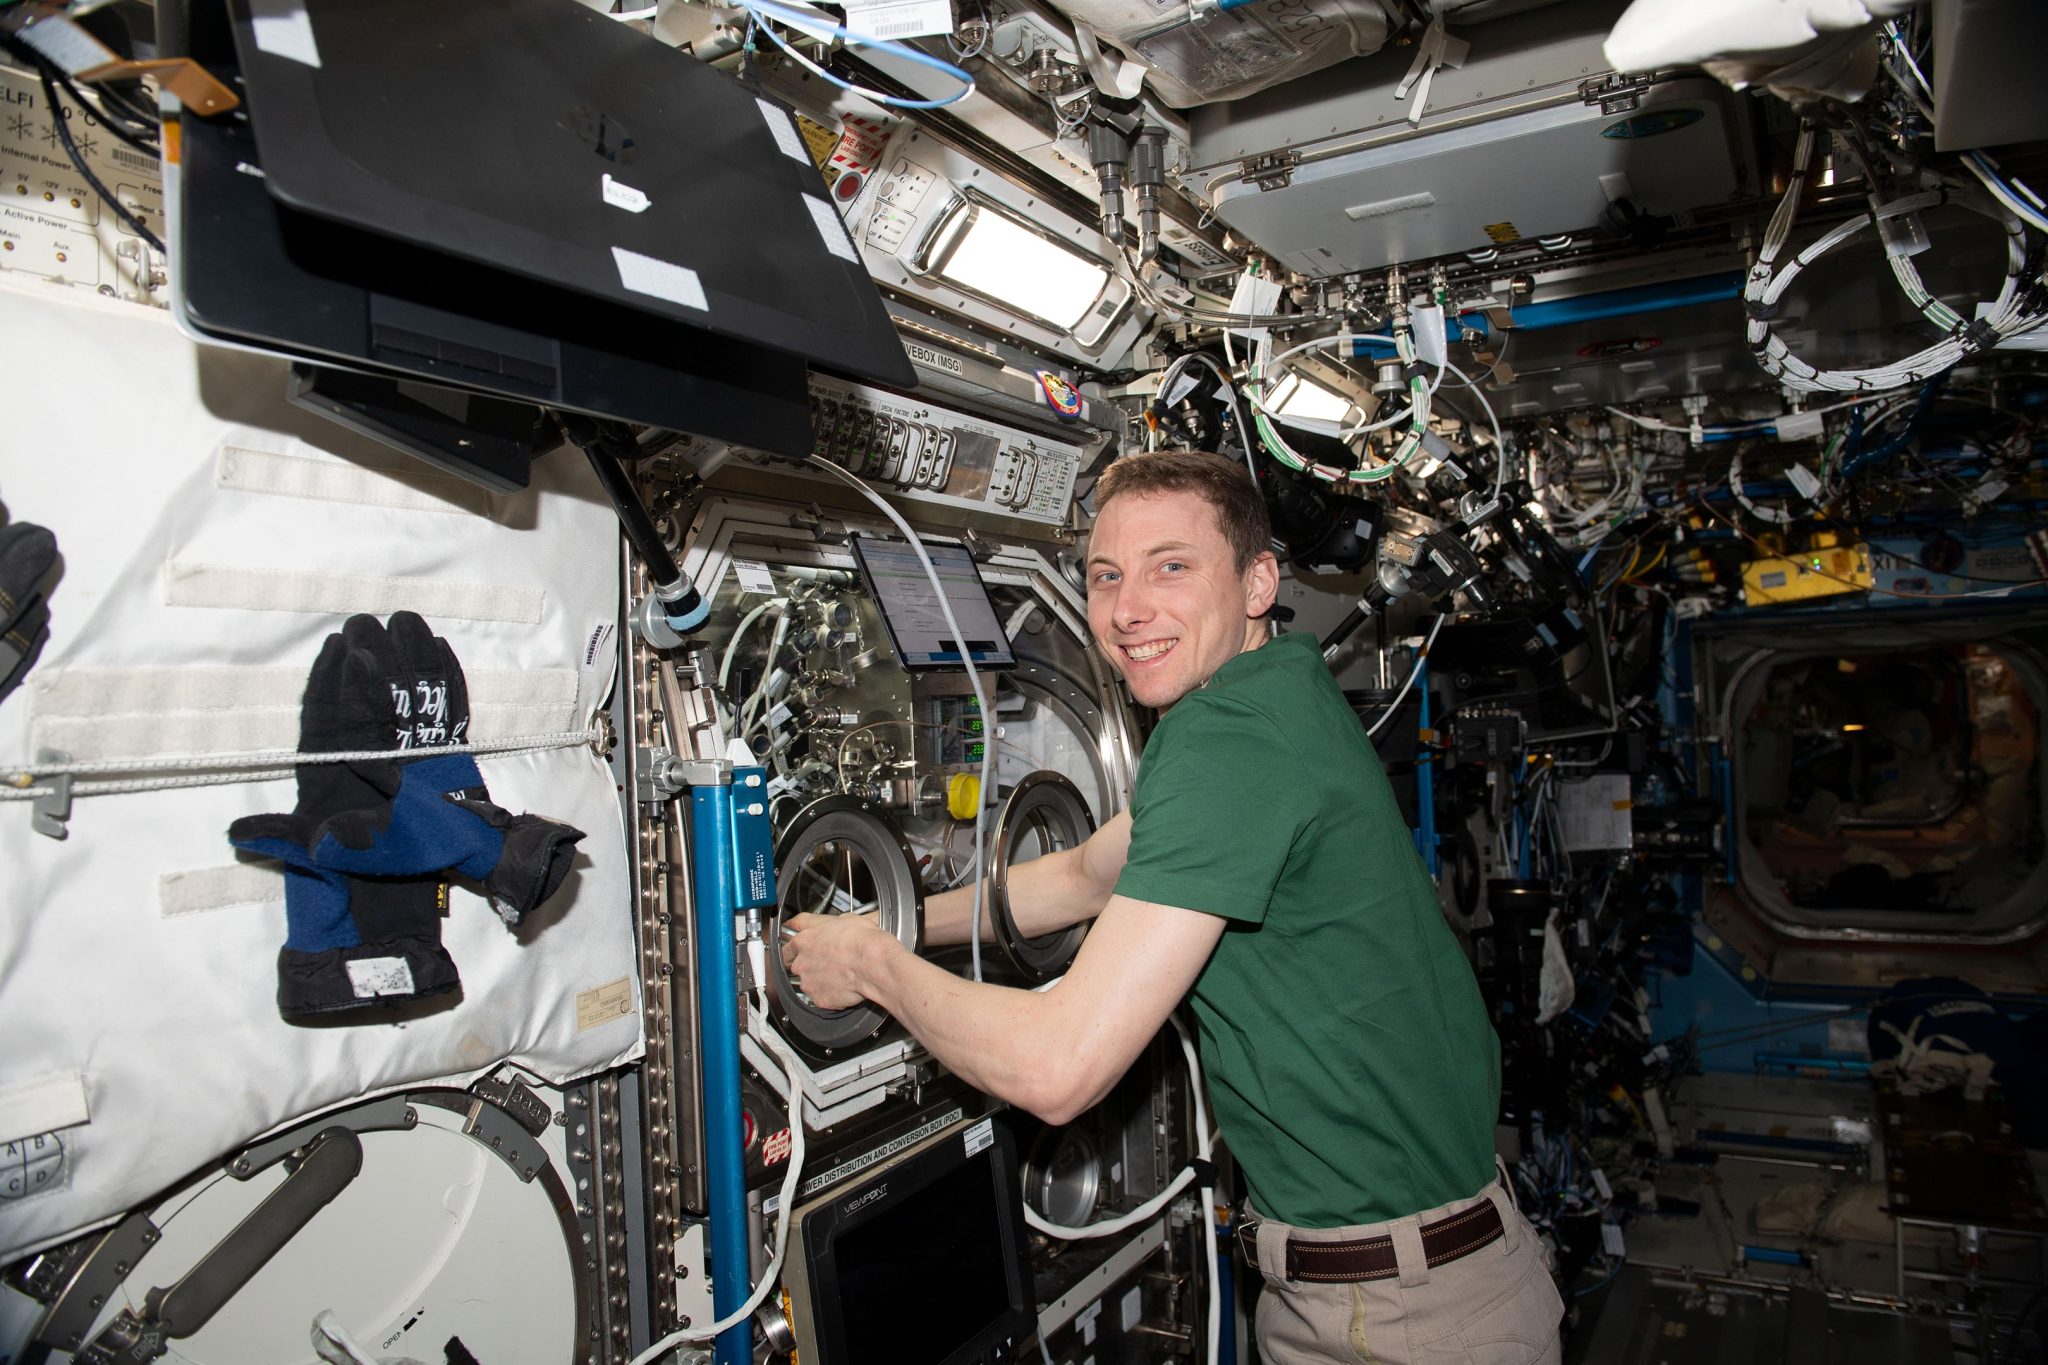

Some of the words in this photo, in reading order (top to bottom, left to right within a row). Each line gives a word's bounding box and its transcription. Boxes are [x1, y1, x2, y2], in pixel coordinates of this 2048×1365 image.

[801, 126, 828, 143] WARNING
[1, 145, 39, 162] Internal
[41, 155, 72, 171] Power
[855, 141, 874, 155] PORT
[4, 208, 35, 223] Active
[37, 217, 68, 230] Power
[937, 356, 962, 374] (MSG)
[881, 404, 893, 414] SPECIAL
[893, 407, 910, 418] FUNCTIONS
[7, 1142, 17, 1157] A
[35, 1135, 45, 1149] B
[795, 1178, 823, 1197] POWER
[824, 1155, 873, 1185] DISTRIBUTION
[873, 1147, 888, 1161] AND
[888, 1128, 929, 1154] CONVERSION
[930, 1119, 943, 1132] BOX
[943, 1109, 960, 1127] (PDC)
[9, 1178, 20, 1192] C
[36, 1170, 47, 1183] D
[843, 1184, 888, 1214] VIEWPOINT
